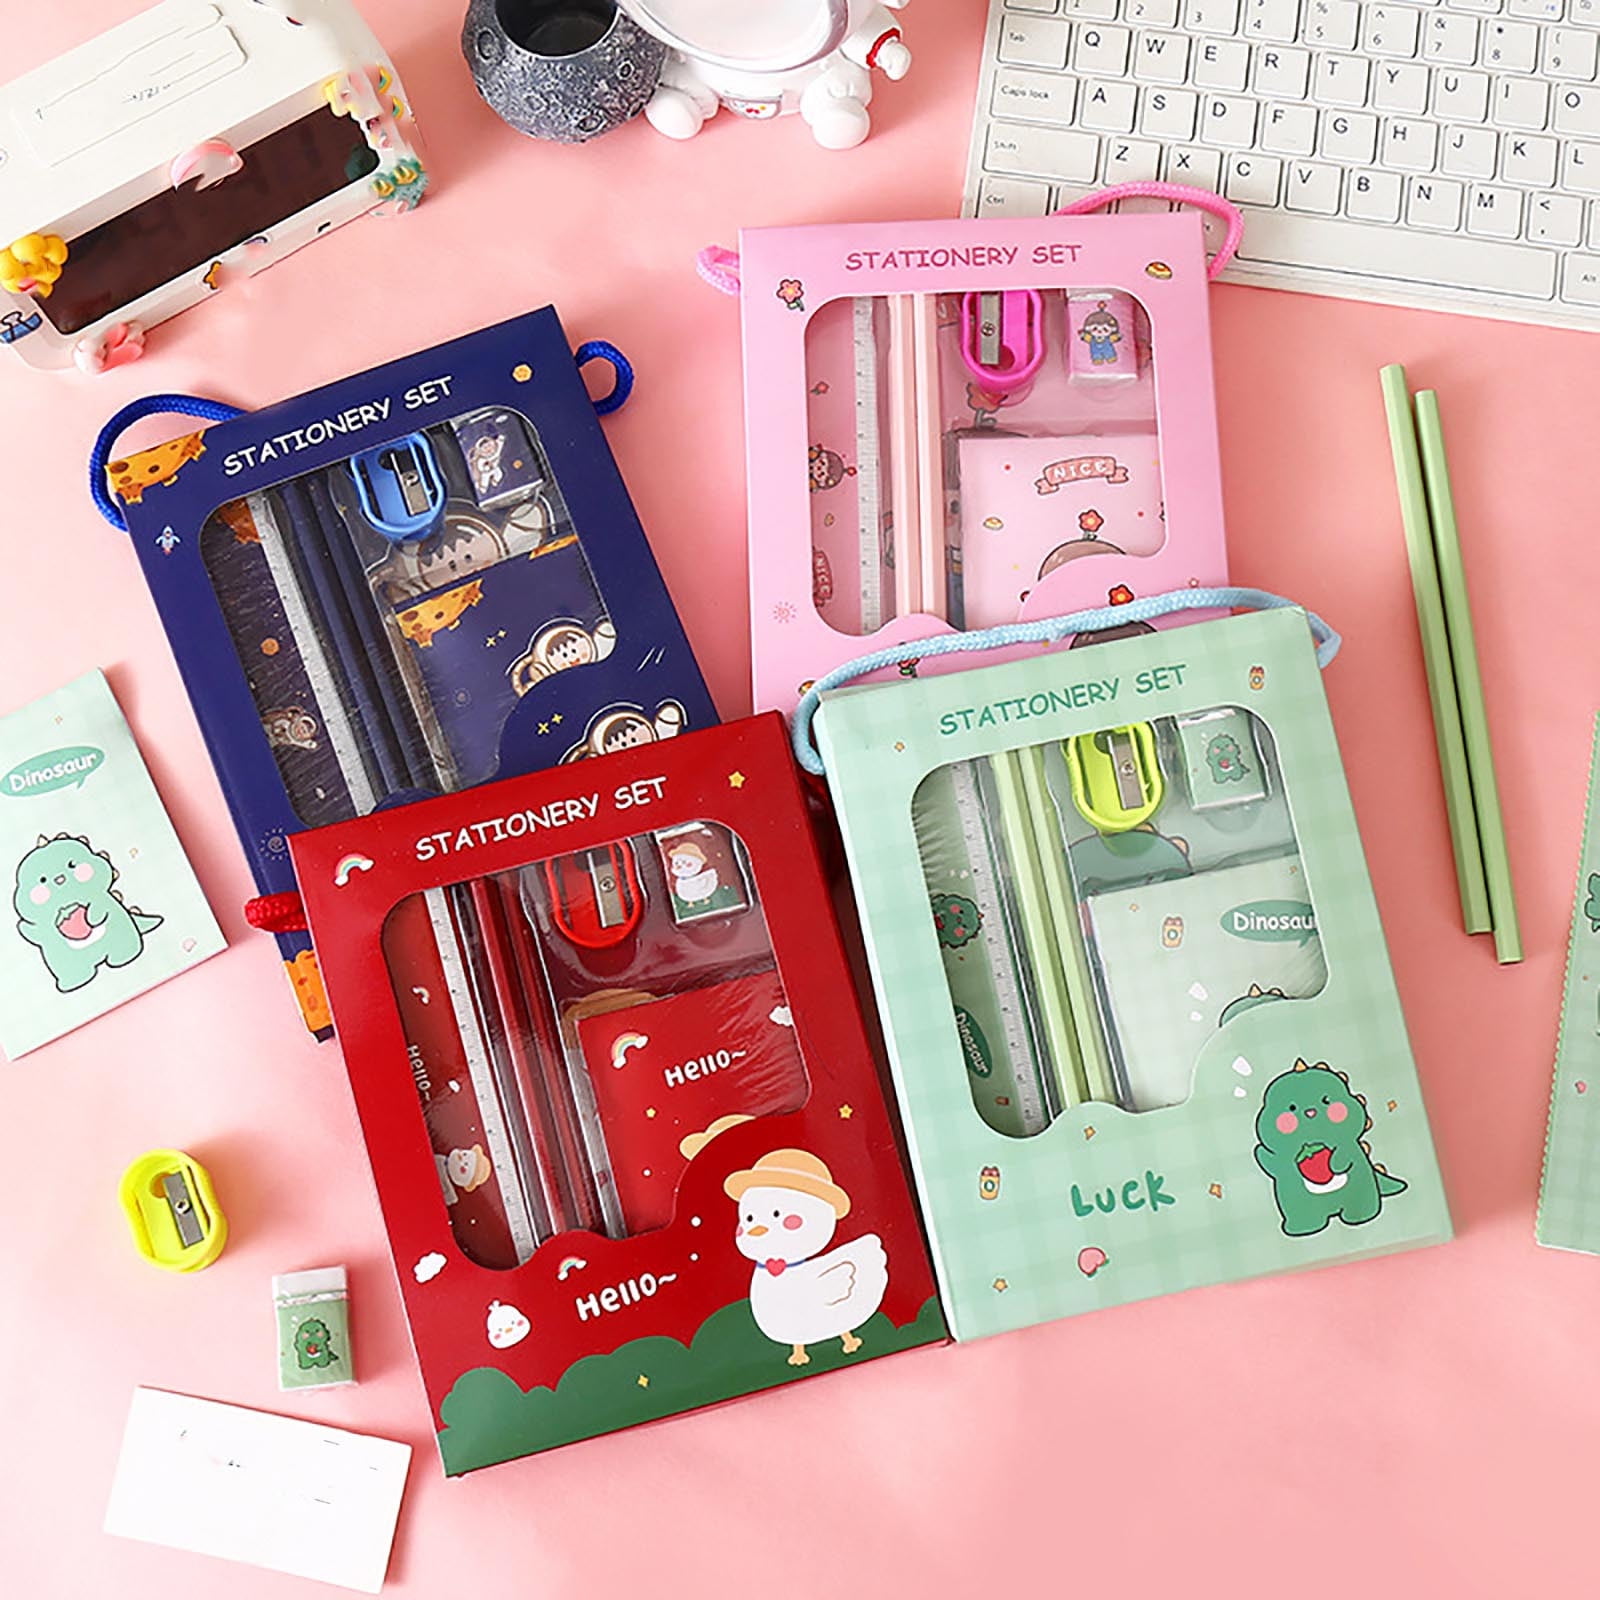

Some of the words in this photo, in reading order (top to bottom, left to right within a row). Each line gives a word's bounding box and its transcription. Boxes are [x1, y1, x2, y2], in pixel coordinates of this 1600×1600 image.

[1136, 5, 1144, 16] 2
[1435, 18, 1446, 29] &
[1085, 31, 1100, 47] Q
[1317, 26, 1323, 38] 5
[1146, 38, 1165, 54] W
[1373, 34, 1381, 46] 6
[1434, 42, 1443, 53] 7
[1204, 45, 1217, 61] E
[1265, 53, 1278, 68] R
[1492, 49, 1500, 60] 8
[1327, 61, 1339, 75] T
[1552, 58, 1560, 68] 9
[1387, 69, 1399, 84] Y
[1445, 77, 1458, 92] U
[1092, 87, 1107, 103] A
[1565, 92, 1580, 108] O
[1153, 95, 1166, 111] S
[1213, 102, 1226, 117] D
[1272, 110, 1284, 125] F
[1333, 118, 1348, 134] G
[1393, 126, 1407, 140] H
[1453, 134, 1464, 149] J
[1115, 145, 1129, 161] Z
[1513, 142, 1527, 157] K
[1574, 149, 1584, 165] L
[1176, 153, 1191, 169] X
[1236, 161, 1251, 177] C
[1299, 169, 1312, 184] V
[1357, 177, 1370, 192] B
[1418, 185, 1432, 200] N
[1477, 193, 1494, 208] M
[1540, 200, 1550, 210] <
[845, 246, 1018, 270] STATIONERY
[1032, 244, 1082, 264] SET
[223, 397, 391, 476] STATIONERY
[404, 376, 452, 409] SET
[1053, 461, 1107, 478] NICE
[940, 677, 1120, 736] STATIONERY
[1135, 664, 1187, 694] SET
[9, 753, 97, 792] Dinosaur
[415, 793, 599, 861] STATIONERY
[614, 776, 667, 809] SET
[1233, 911, 1315, 932] Dinosau
[956, 1012, 989, 1074] Dinosaur
[1071, 1170, 1176, 1217] LUCK
